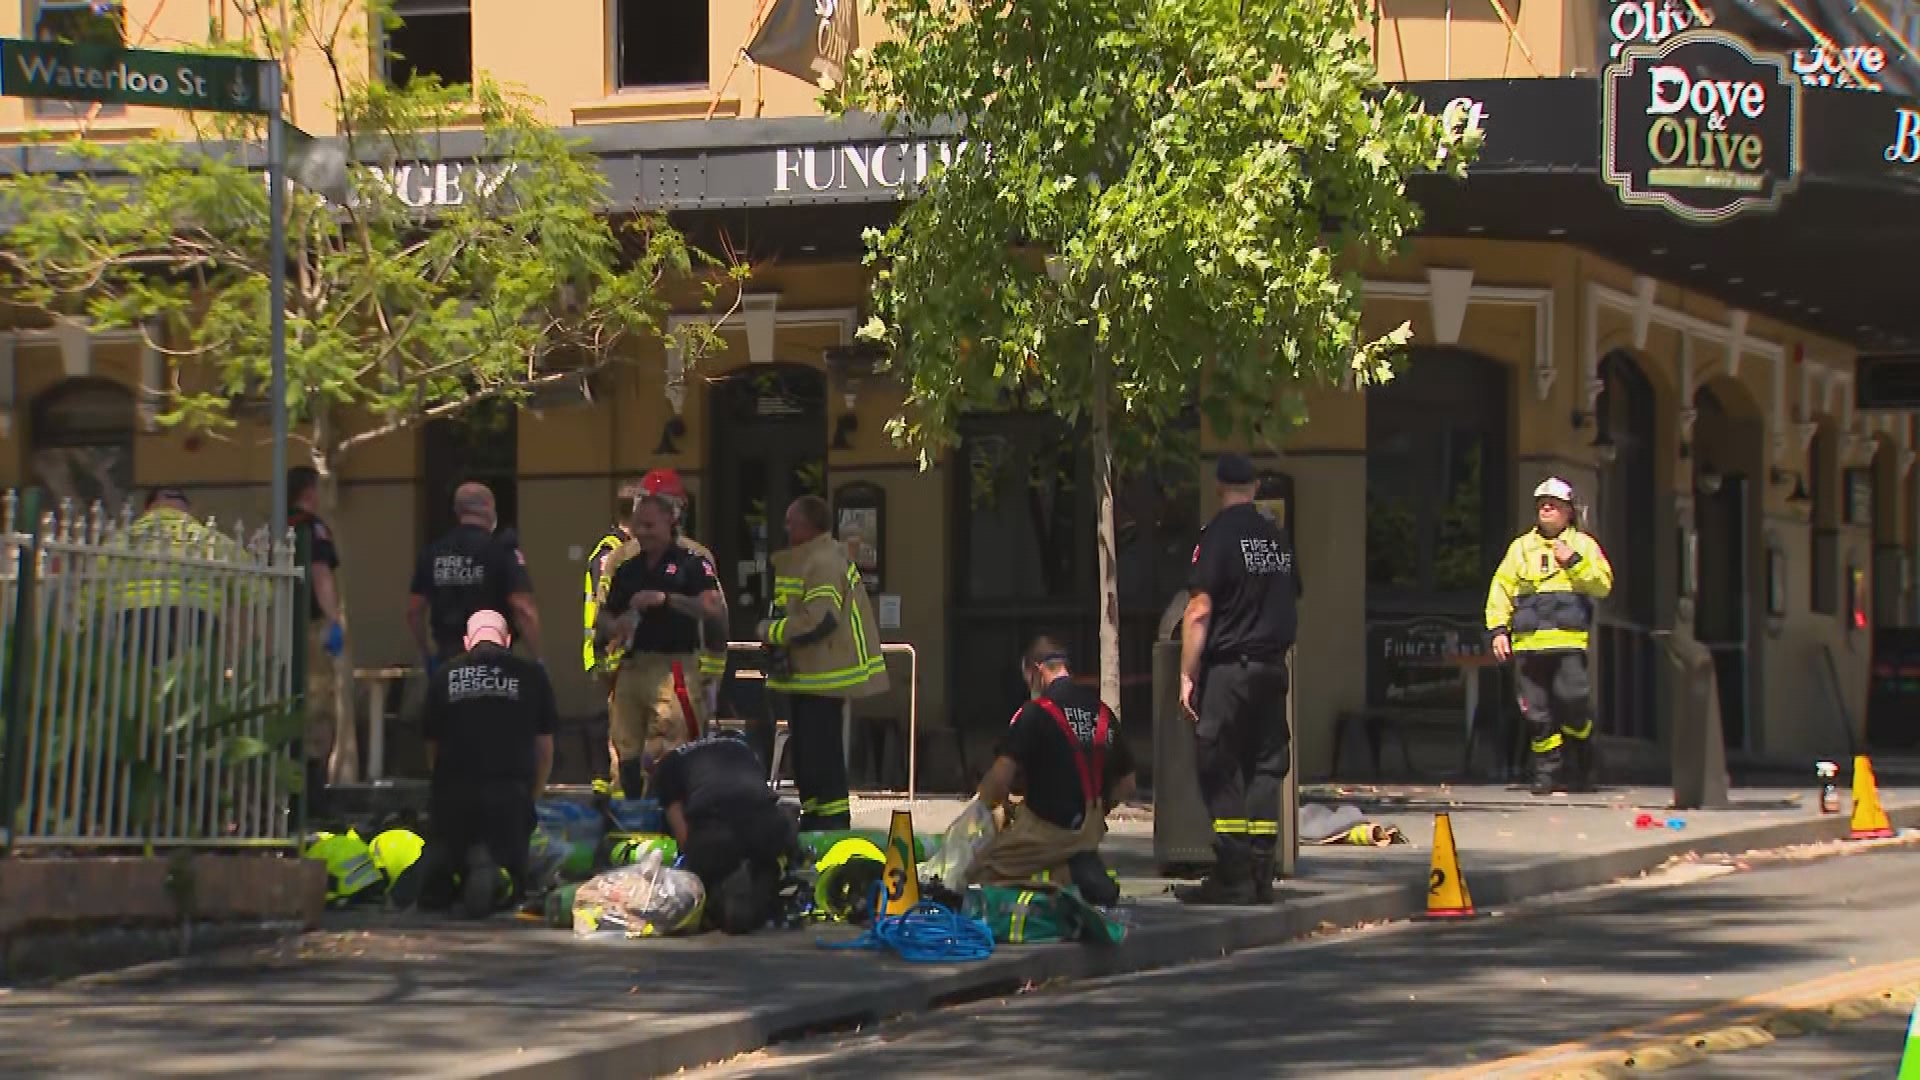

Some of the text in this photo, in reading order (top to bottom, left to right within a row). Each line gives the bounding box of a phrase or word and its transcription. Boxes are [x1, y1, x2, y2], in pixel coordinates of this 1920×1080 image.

[1609, 0, 1697, 42] Oliv
[18, 53, 207, 97] Waterloo St
[1646, 66, 1767, 118] Dove
[1707, 110, 1728, 131] &
[1647, 117, 1763, 169] Olive
[448, 677, 520, 694] RESCUE
[887, 867, 908, 902] 3
[1429, 867, 1446, 896] 2
